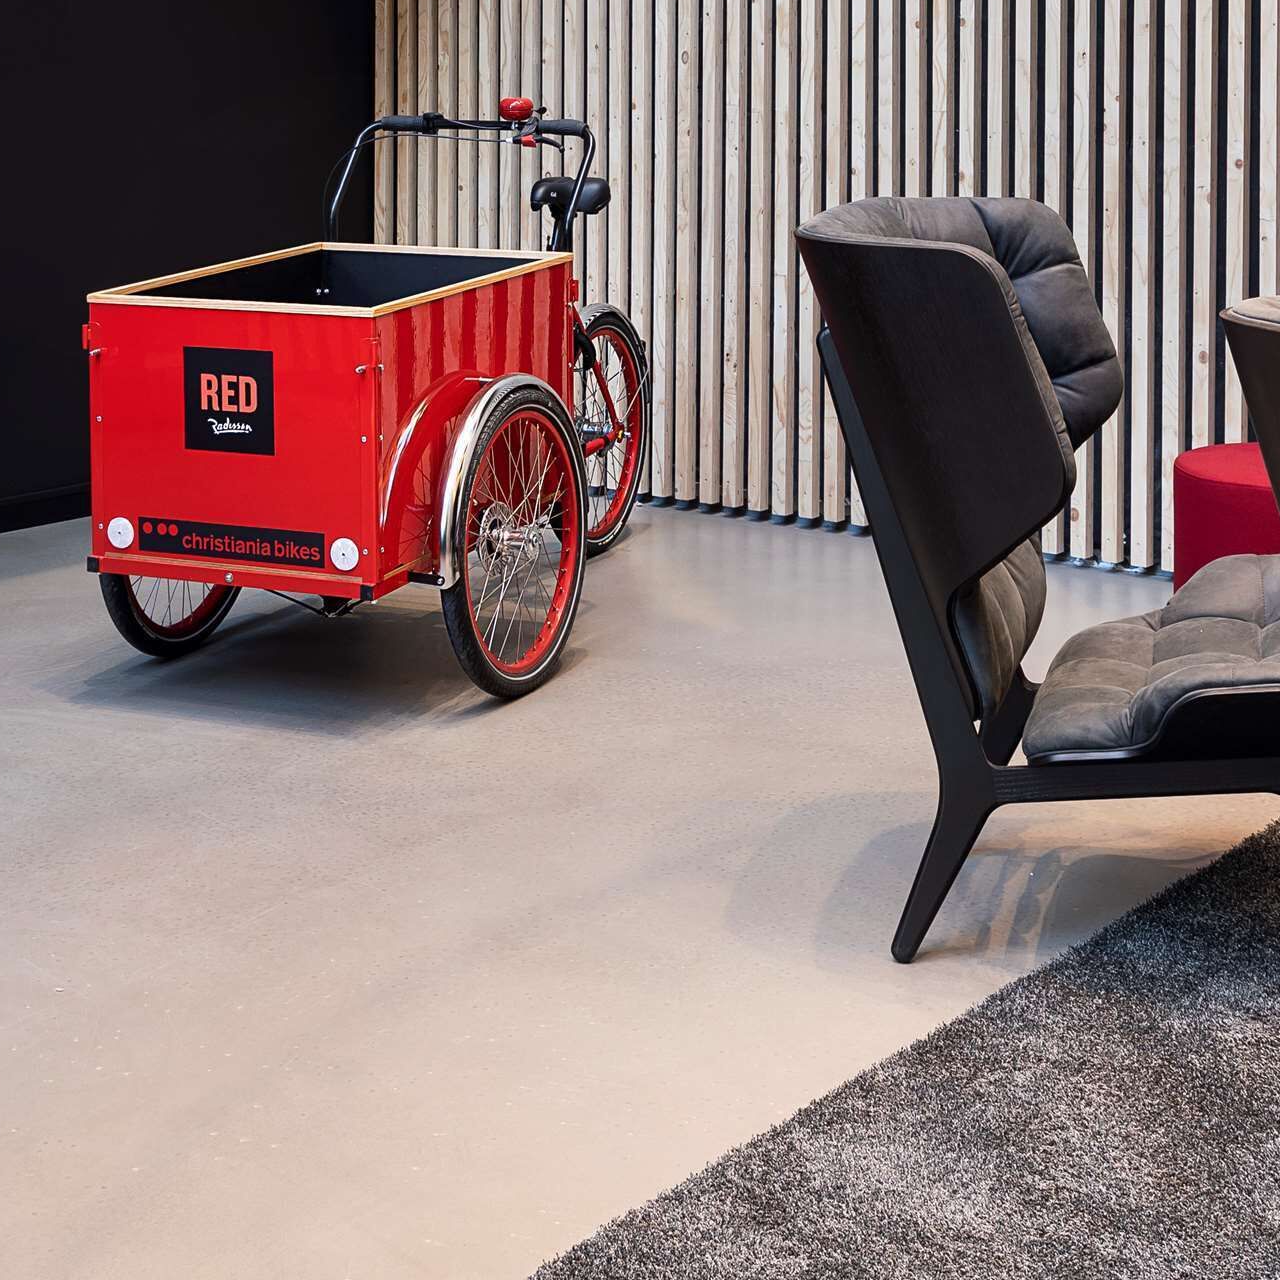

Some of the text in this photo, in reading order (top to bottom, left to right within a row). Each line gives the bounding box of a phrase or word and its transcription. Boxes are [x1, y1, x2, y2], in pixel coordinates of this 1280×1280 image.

[200, 373, 257, 413] RED
[207, 417, 252, 435] Radisson
[182, 532, 321, 561] christiania bikes
